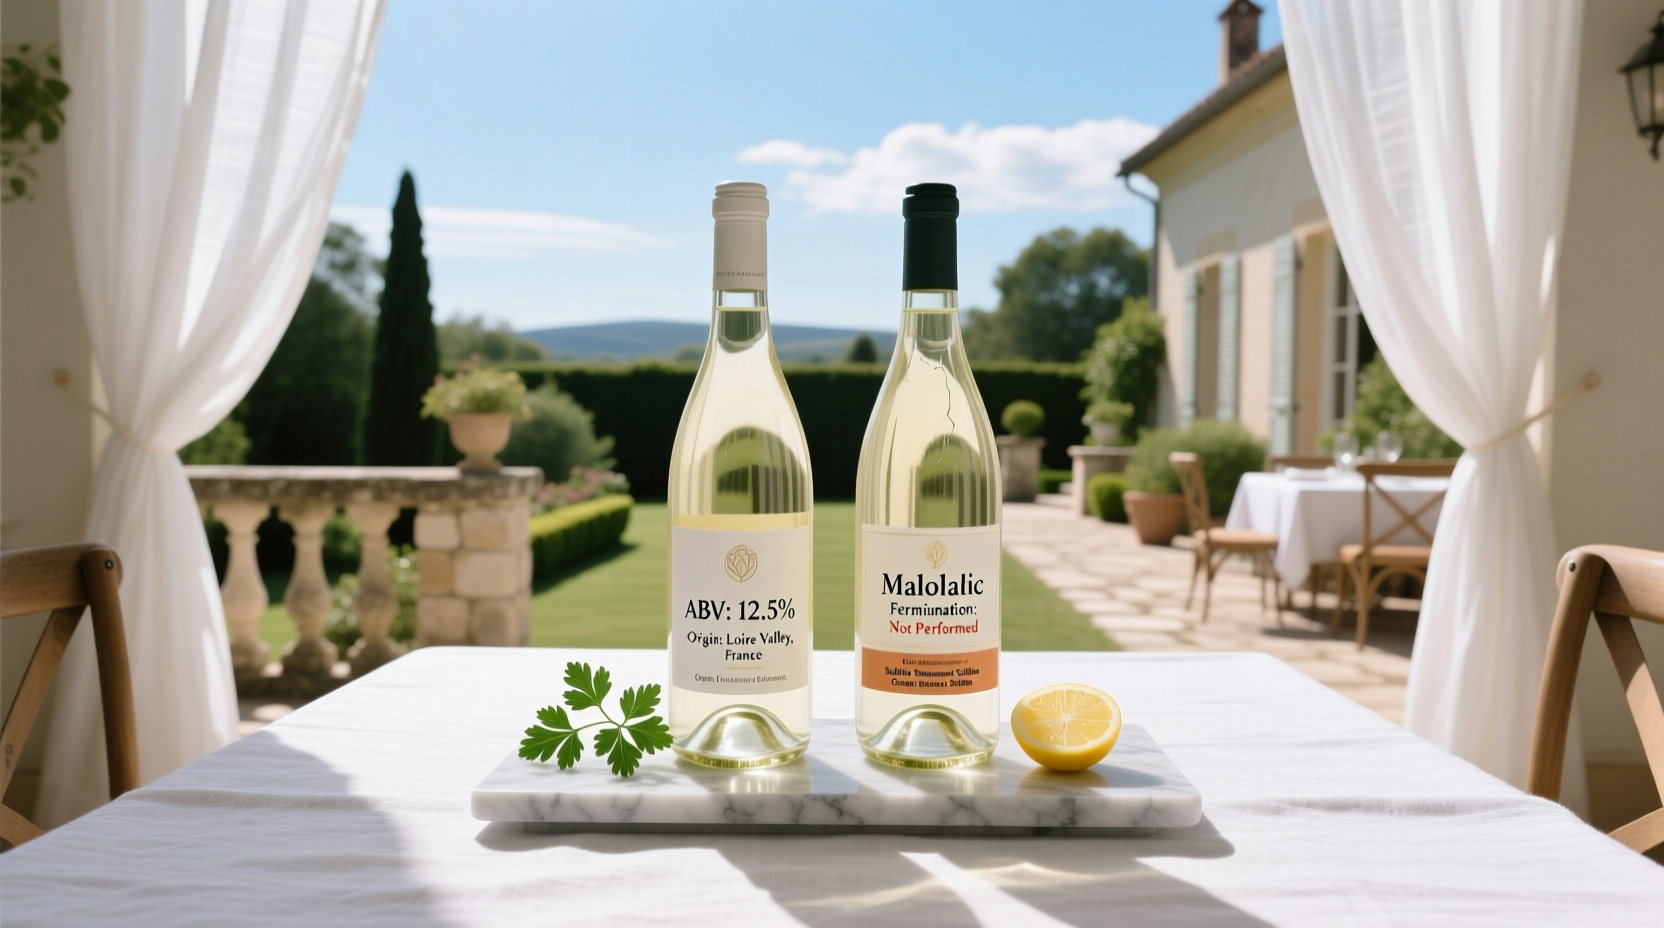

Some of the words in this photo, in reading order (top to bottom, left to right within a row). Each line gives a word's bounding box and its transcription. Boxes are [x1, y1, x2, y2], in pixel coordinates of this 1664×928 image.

[685, 599, 731, 621] ABV:
[738, 598, 795, 621] 12.5%
[889, 620, 912, 634] Not
[916, 619, 978, 635] Performed
[726, 633, 757, 645] Loire
[725, 649, 763, 661] France
